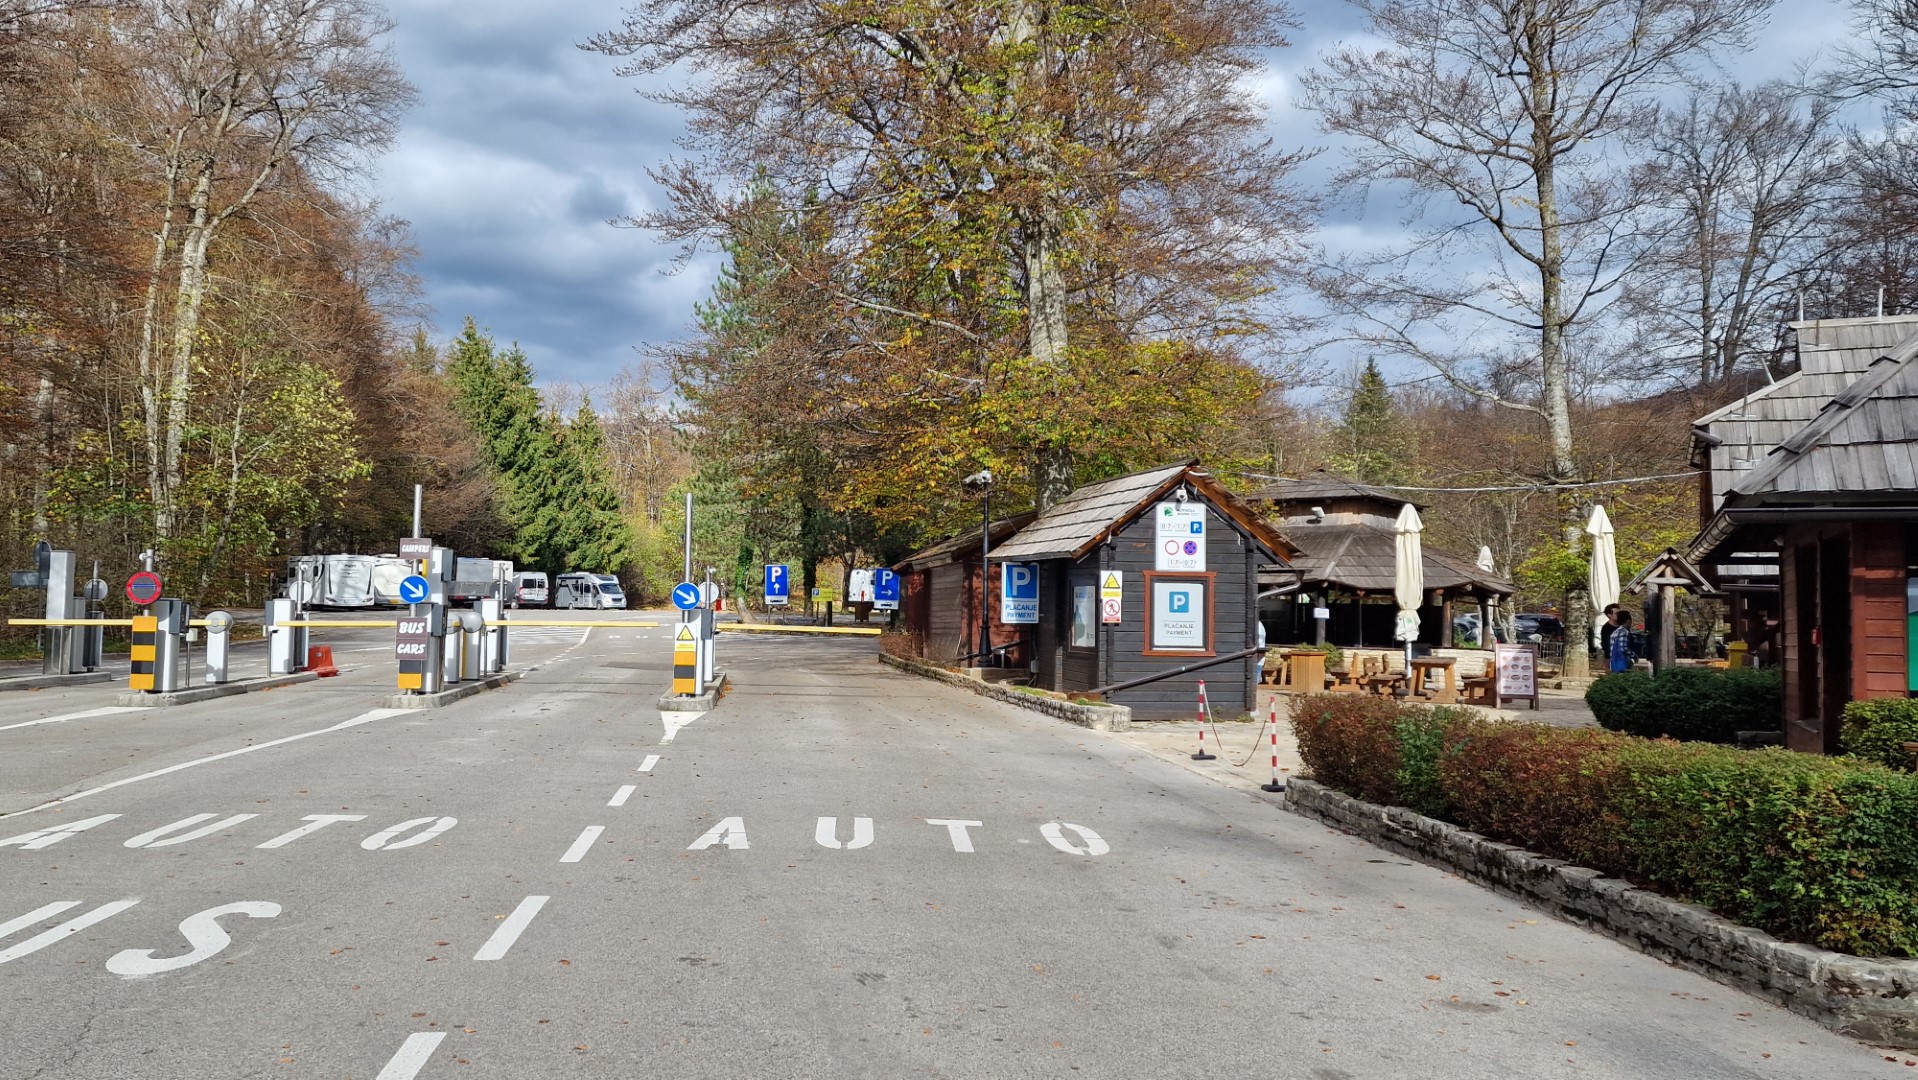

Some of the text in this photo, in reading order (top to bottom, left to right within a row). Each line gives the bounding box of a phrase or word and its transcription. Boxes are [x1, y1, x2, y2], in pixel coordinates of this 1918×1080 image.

[402, 545, 429, 553] CAMPERS
[771, 567, 782, 582] P
[882, 571, 893, 586] P
[1012, 567, 1031, 596] P
[1173, 594, 1186, 610] P
[399, 622, 425, 634] BUS
[397, 643, 426, 654] CARS
[687, 816, 1111, 856] AUTO
